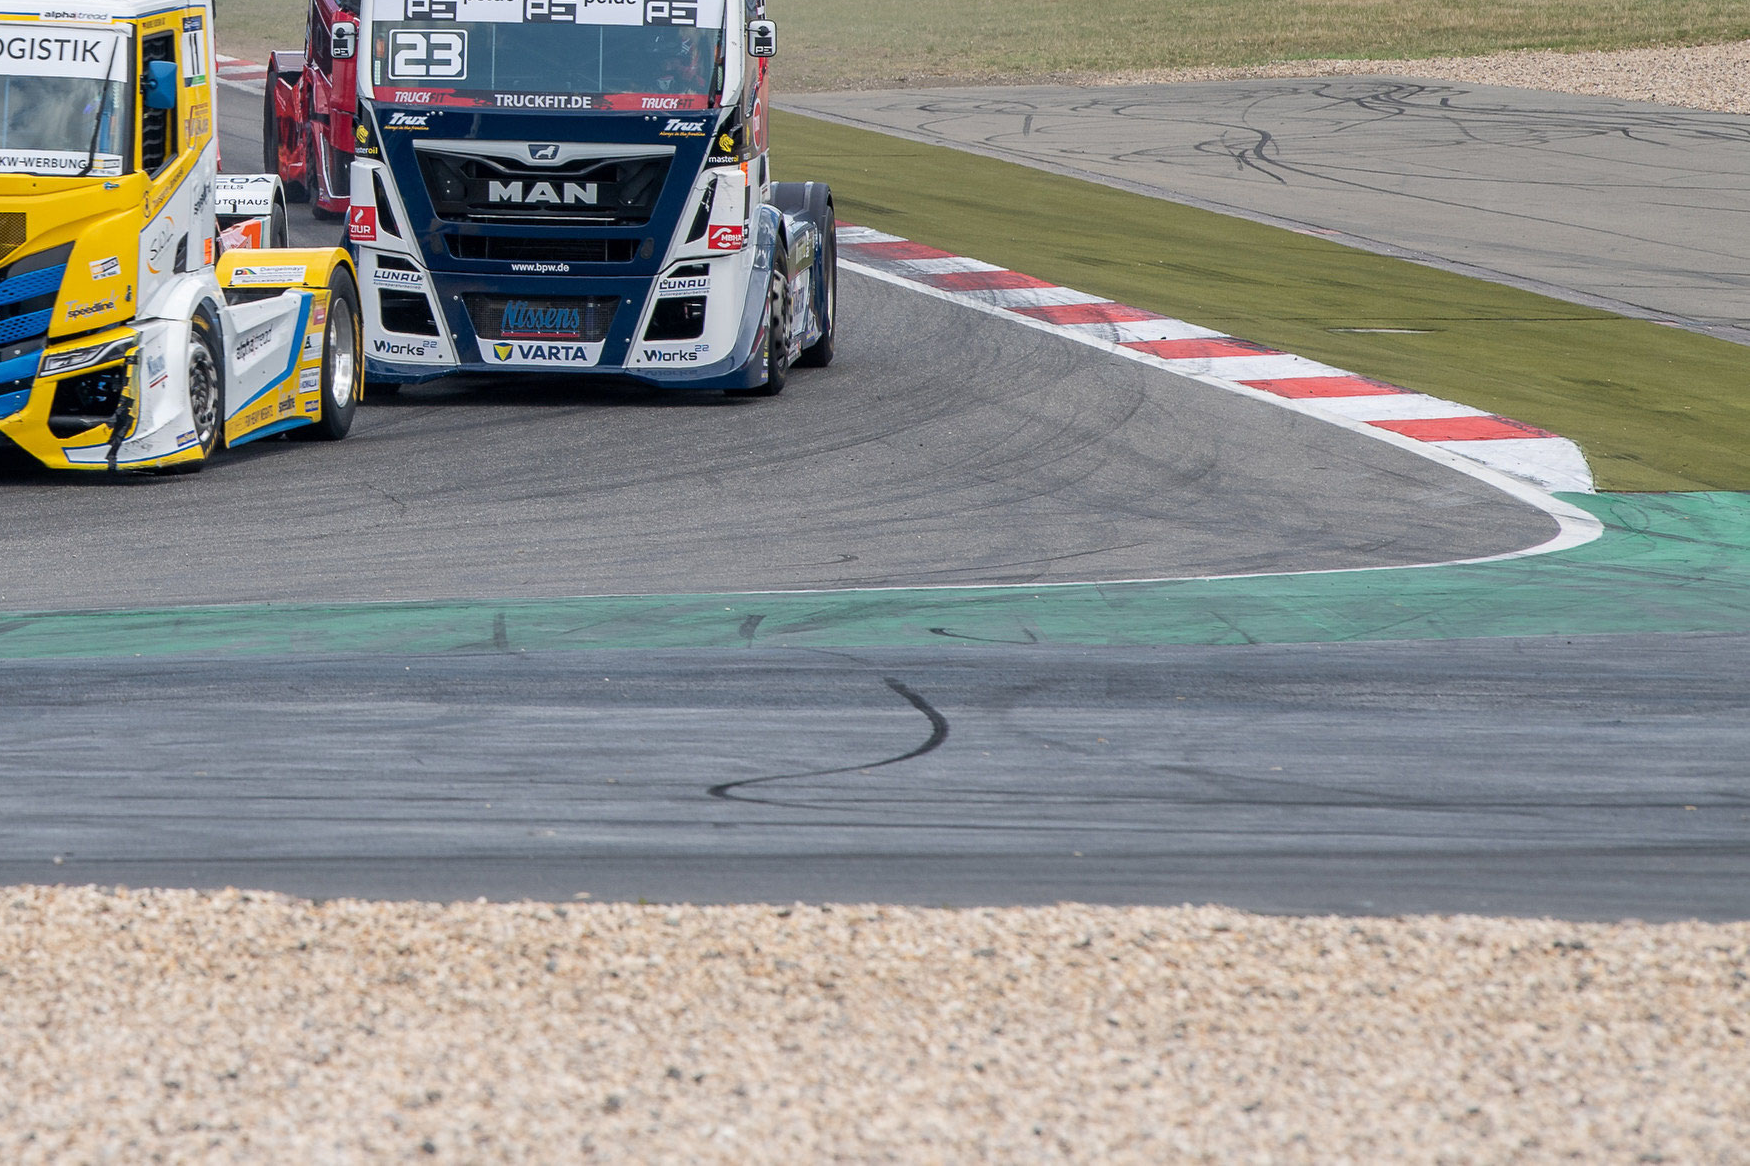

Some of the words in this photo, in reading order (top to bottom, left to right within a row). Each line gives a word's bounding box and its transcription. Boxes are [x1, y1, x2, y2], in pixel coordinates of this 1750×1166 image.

[646, 1, 698, 24] PE
[394, 33, 463, 77] 23
[394, 91, 446, 103] TRUCKFIT
[494, 94, 592, 109] TRUCKFIT.DE
[641, 97, 694, 109] TRUCKFIT
[389, 112, 429, 126] Trux
[664, 119, 705, 132] Trux
[488, 180, 598, 205] MAN
[215, 198, 269, 206] UTOHAUS
[511, 263, 569, 273] www.bpw.de
[374, 270, 420, 283] LUNAU
[659, 278, 707, 290] LUNAU
[501, 300, 580, 329] Nissens
[517, 345, 588, 361] VARTA
